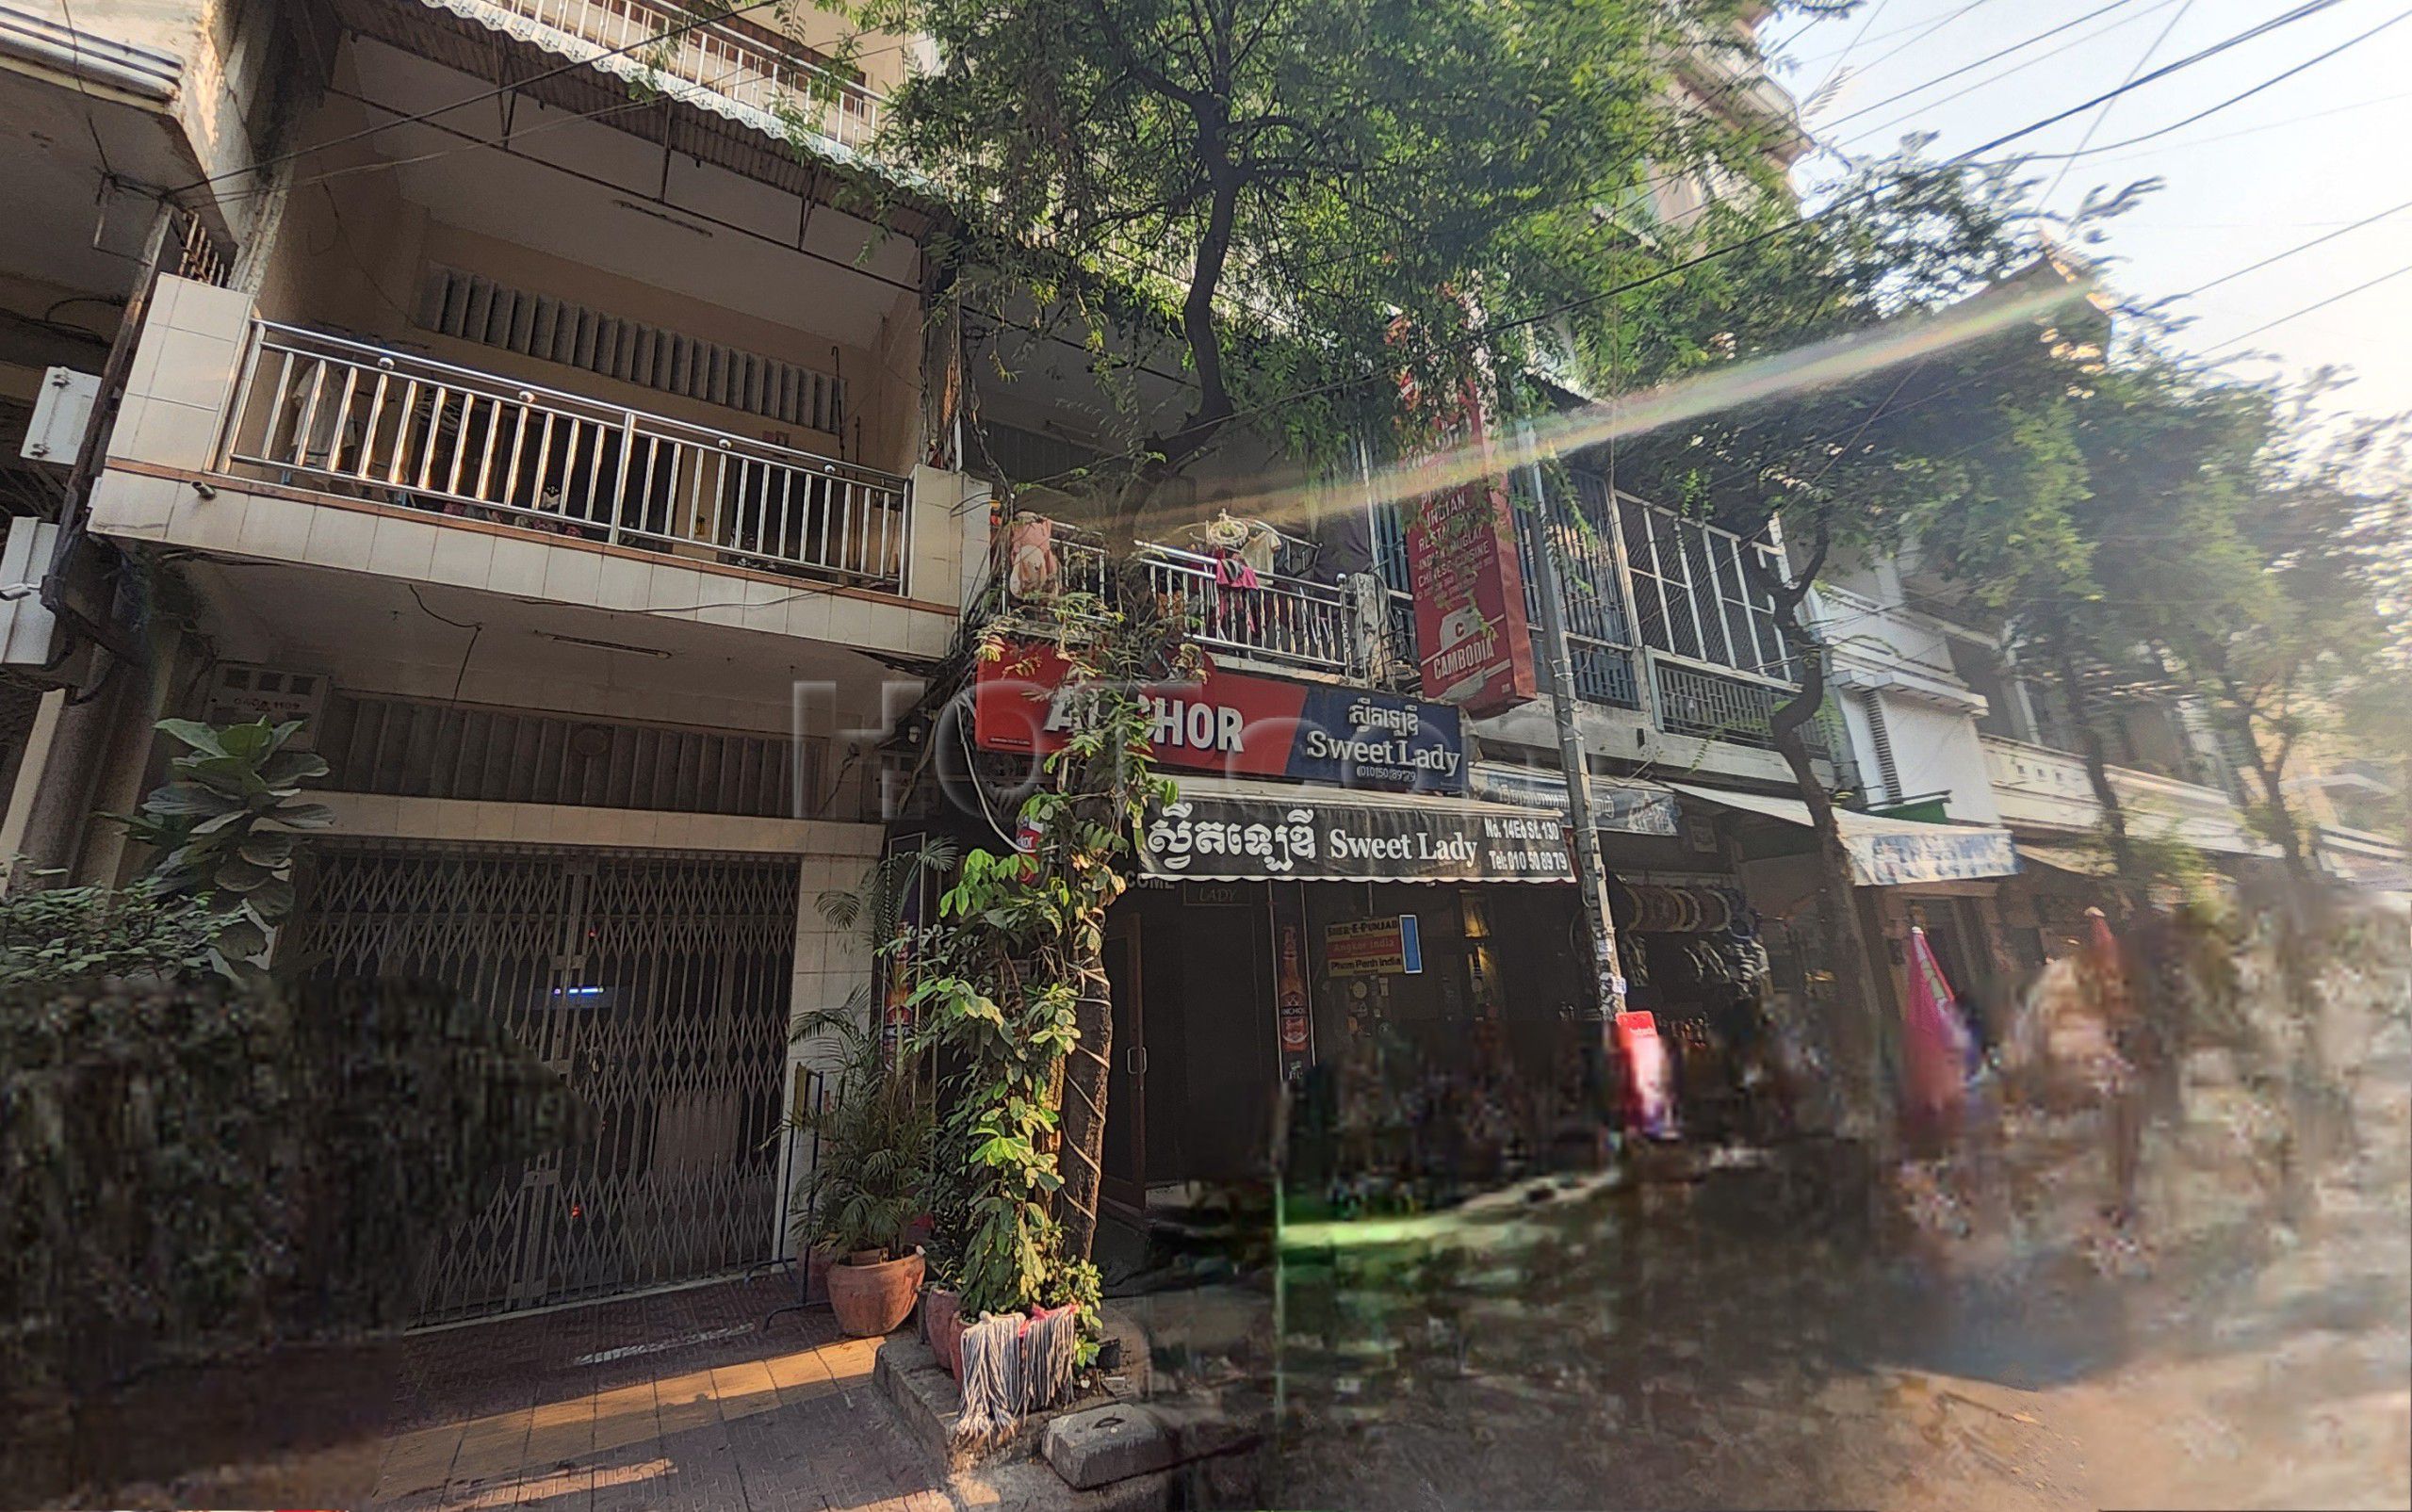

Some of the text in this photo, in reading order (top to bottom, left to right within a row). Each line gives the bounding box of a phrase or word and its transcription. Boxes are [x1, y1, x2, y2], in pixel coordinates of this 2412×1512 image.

[1455, 623, 1465, 638] C
[1433, 635, 1495, 680] CAMBODIA
[1043, 682, 1245, 753] AHOR
[1307, 730, 1461, 777] Sweet Lady
[1330, 828, 1478, 868] Sweet Lady
[1541, 821, 1559, 840] 130
